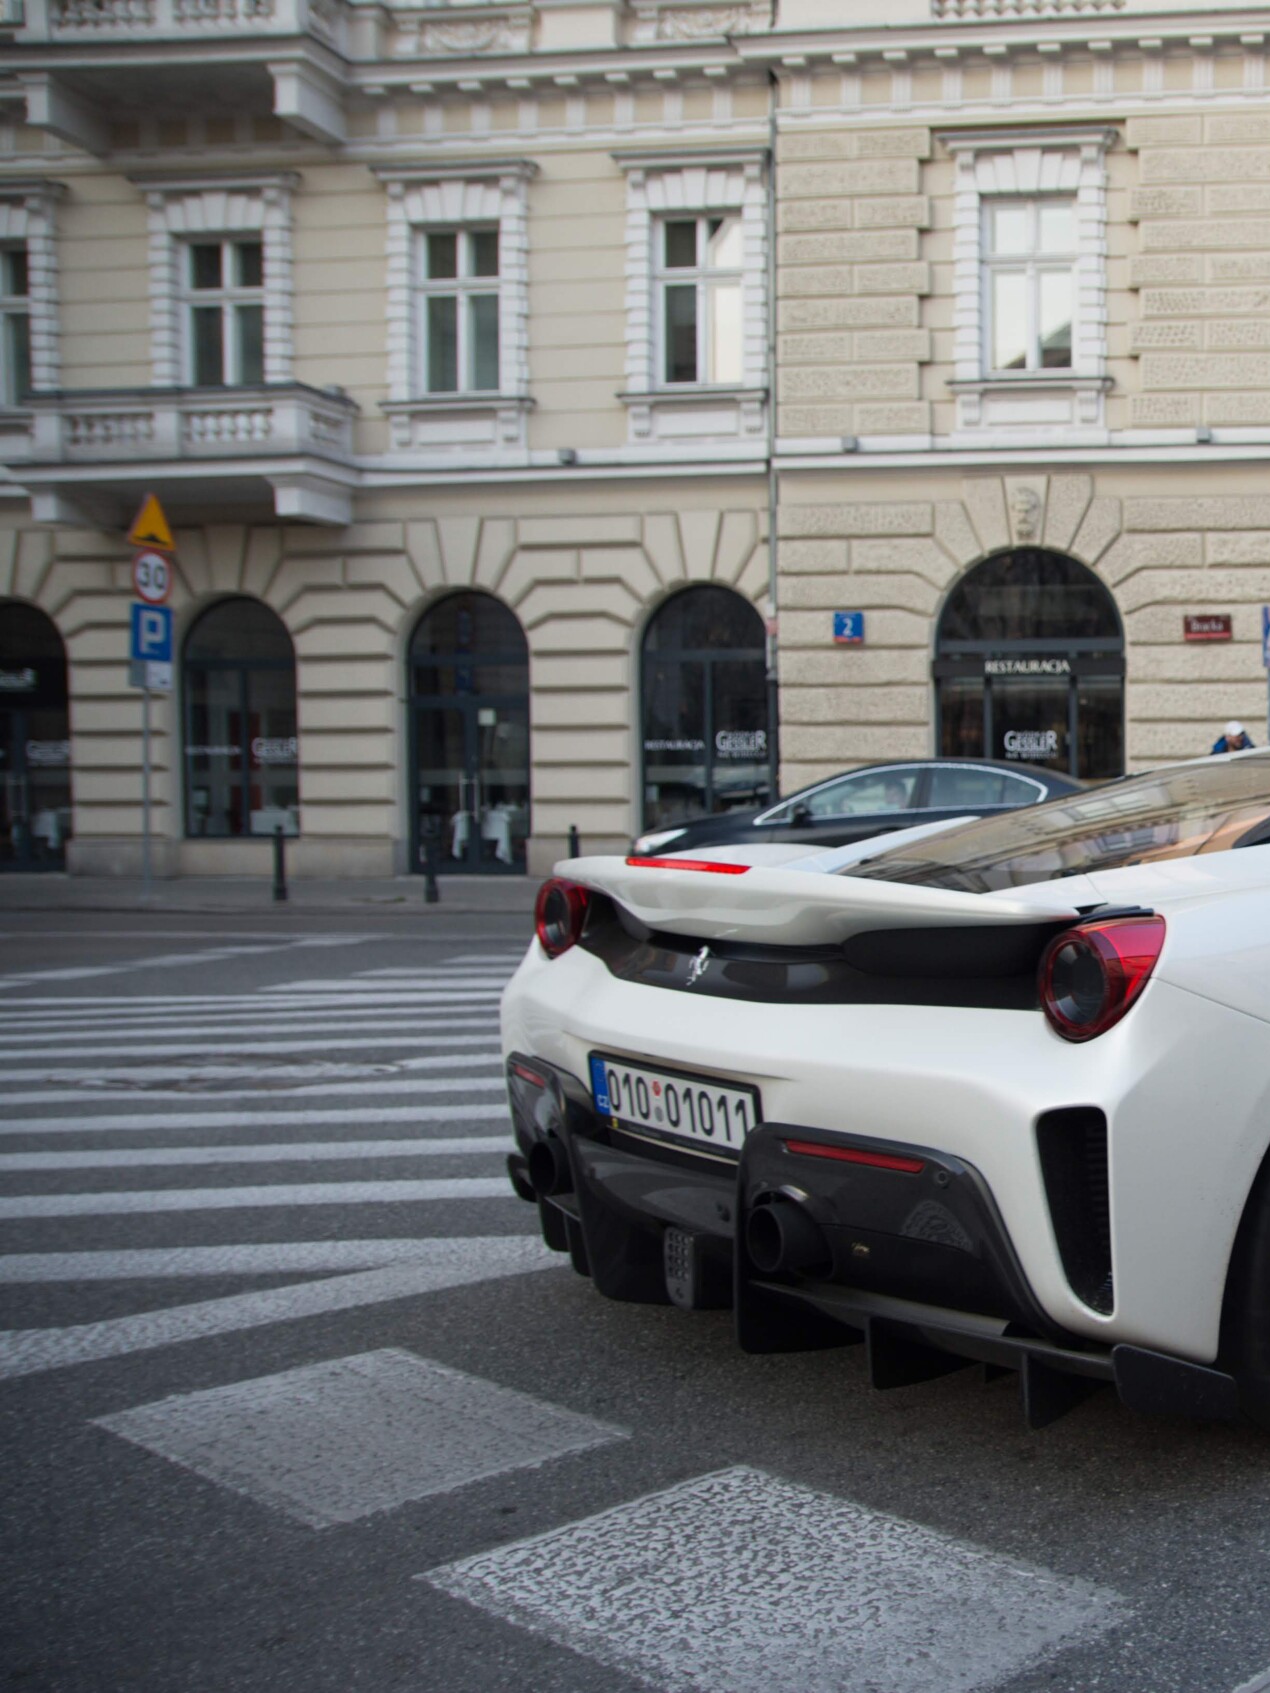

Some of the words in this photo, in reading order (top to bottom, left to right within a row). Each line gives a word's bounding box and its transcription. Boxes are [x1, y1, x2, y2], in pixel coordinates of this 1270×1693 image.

[138, 560, 166, 590] 30
[138, 609, 165, 654] P
[842, 617, 853, 636] 2
[984, 659, 1071, 674] RESTAURACJA
